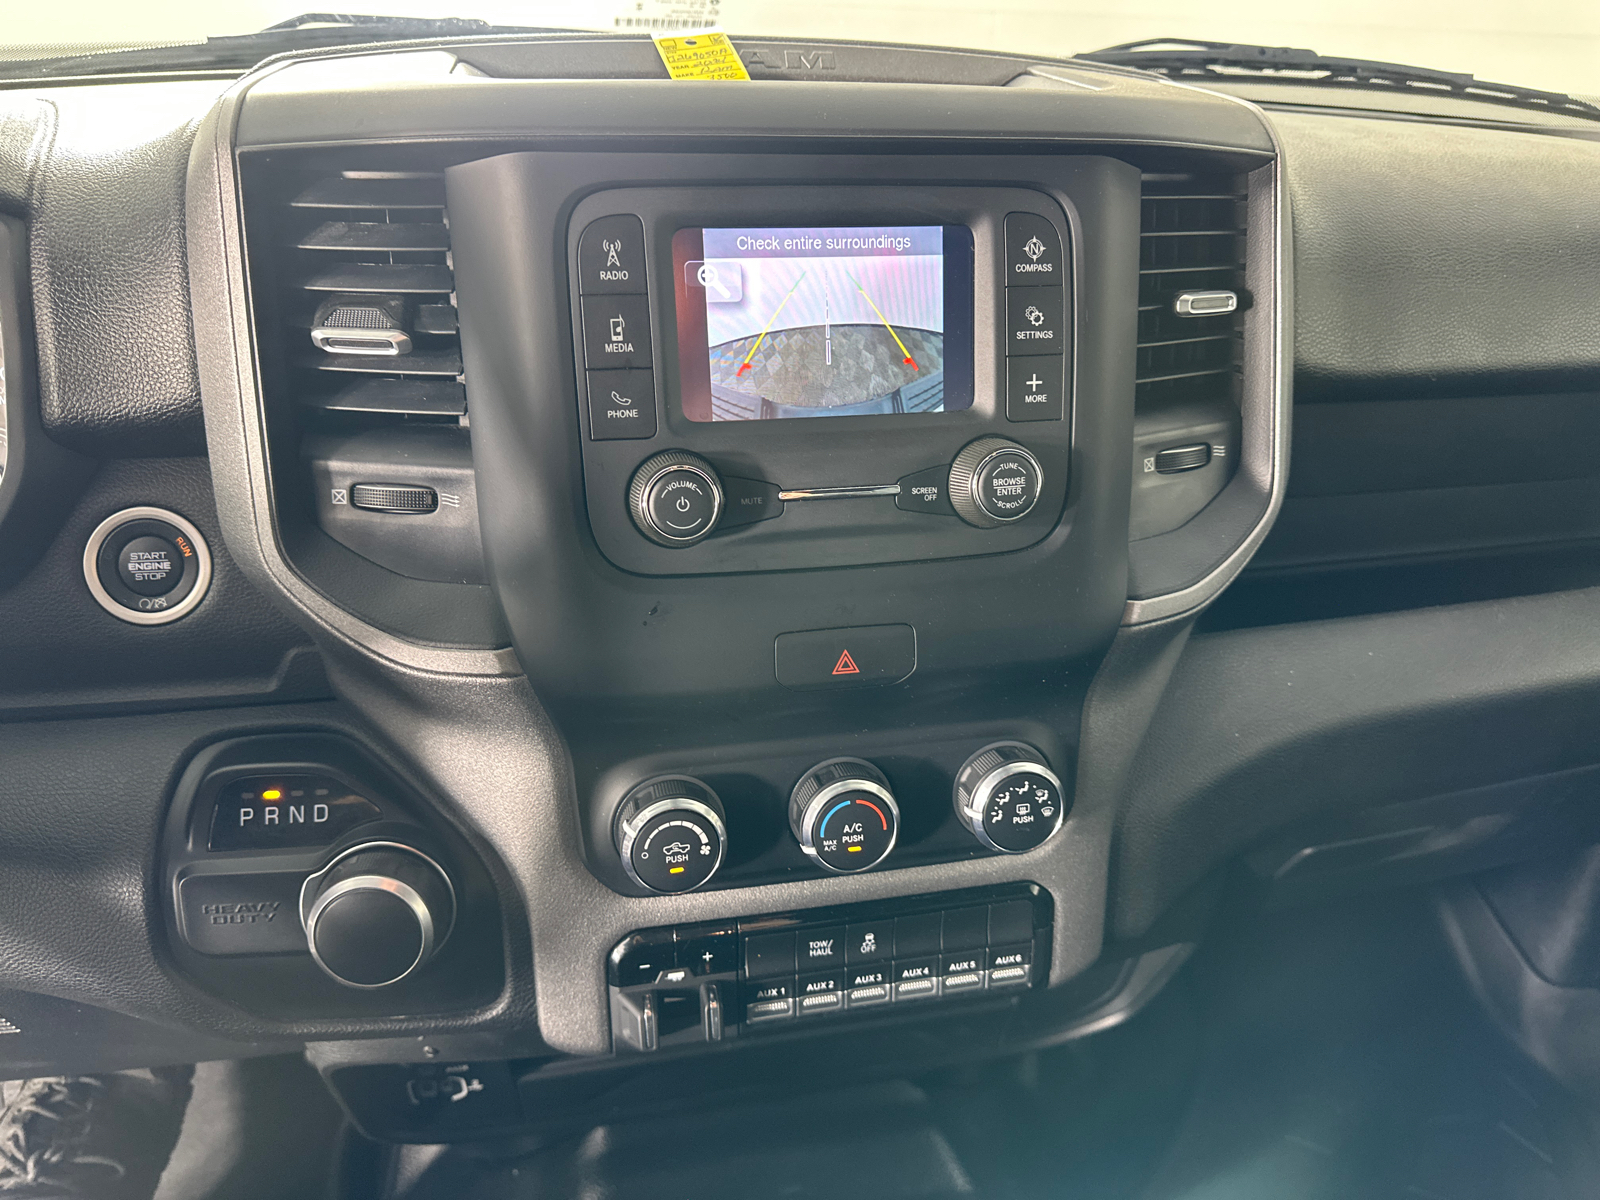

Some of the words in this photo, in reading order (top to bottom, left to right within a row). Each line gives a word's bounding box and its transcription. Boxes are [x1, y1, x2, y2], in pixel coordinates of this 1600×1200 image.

[738, 49, 836, 70] AM
[736, 235, 781, 251] Check
[783, 235, 822, 250] entire
[825, 234, 911, 251] surroundings
[1015, 263, 1053, 273] COMPASS
[599, 270, 629, 281] RADIO
[1016, 330, 1053, 340] SETTINGS
[604, 342, 634, 353] MEDIA
[1024, 394, 1048, 403] MORE
[607, 409, 639, 419] PHONE
[999, 462, 1018, 471] TUNE
[665, 480, 698, 492] VOLUME
[992, 477, 1026, 487] BROWSE
[911, 486, 938, 495] SCREEN
[996, 487, 1022, 497] ENTER
[740, 496, 763, 506] MUTE
[923, 494, 938, 502] OFF
[996, 498, 1024, 510] SCROLL
[175, 536, 193, 558] RUN
[129, 551, 168, 561] START
[127, 561, 172, 571] ENGINE
[134, 572, 167, 581] STOP
[1012, 815, 1034, 824] PUSH
[843, 822, 863, 834] A/C
[842, 834, 864, 844] PUSH
[665, 853, 689, 864] PUSH
[201, 901, 281, 915] HEAVY
[210, 913, 277, 926] DUTY
[809, 939, 834, 949] TOW/
[860, 944, 877, 954] OFF
[809, 948, 834, 958] HAUL
[995, 956, 1014, 966] AUX
[1014, 954, 1022, 963] 6
[948, 962, 968, 972] AUX
[969, 960, 976, 969] 5
[902, 969, 922, 979] AUX
[922, 967, 929, 976] 4
[854, 975, 876, 985] AUX
[876, 973, 883, 982] 3
[806, 983, 828, 992] AUX
[828, 980, 835, 989] 2
[756, 988, 779, 998] AUX
[780, 986, 786, 996] 1
